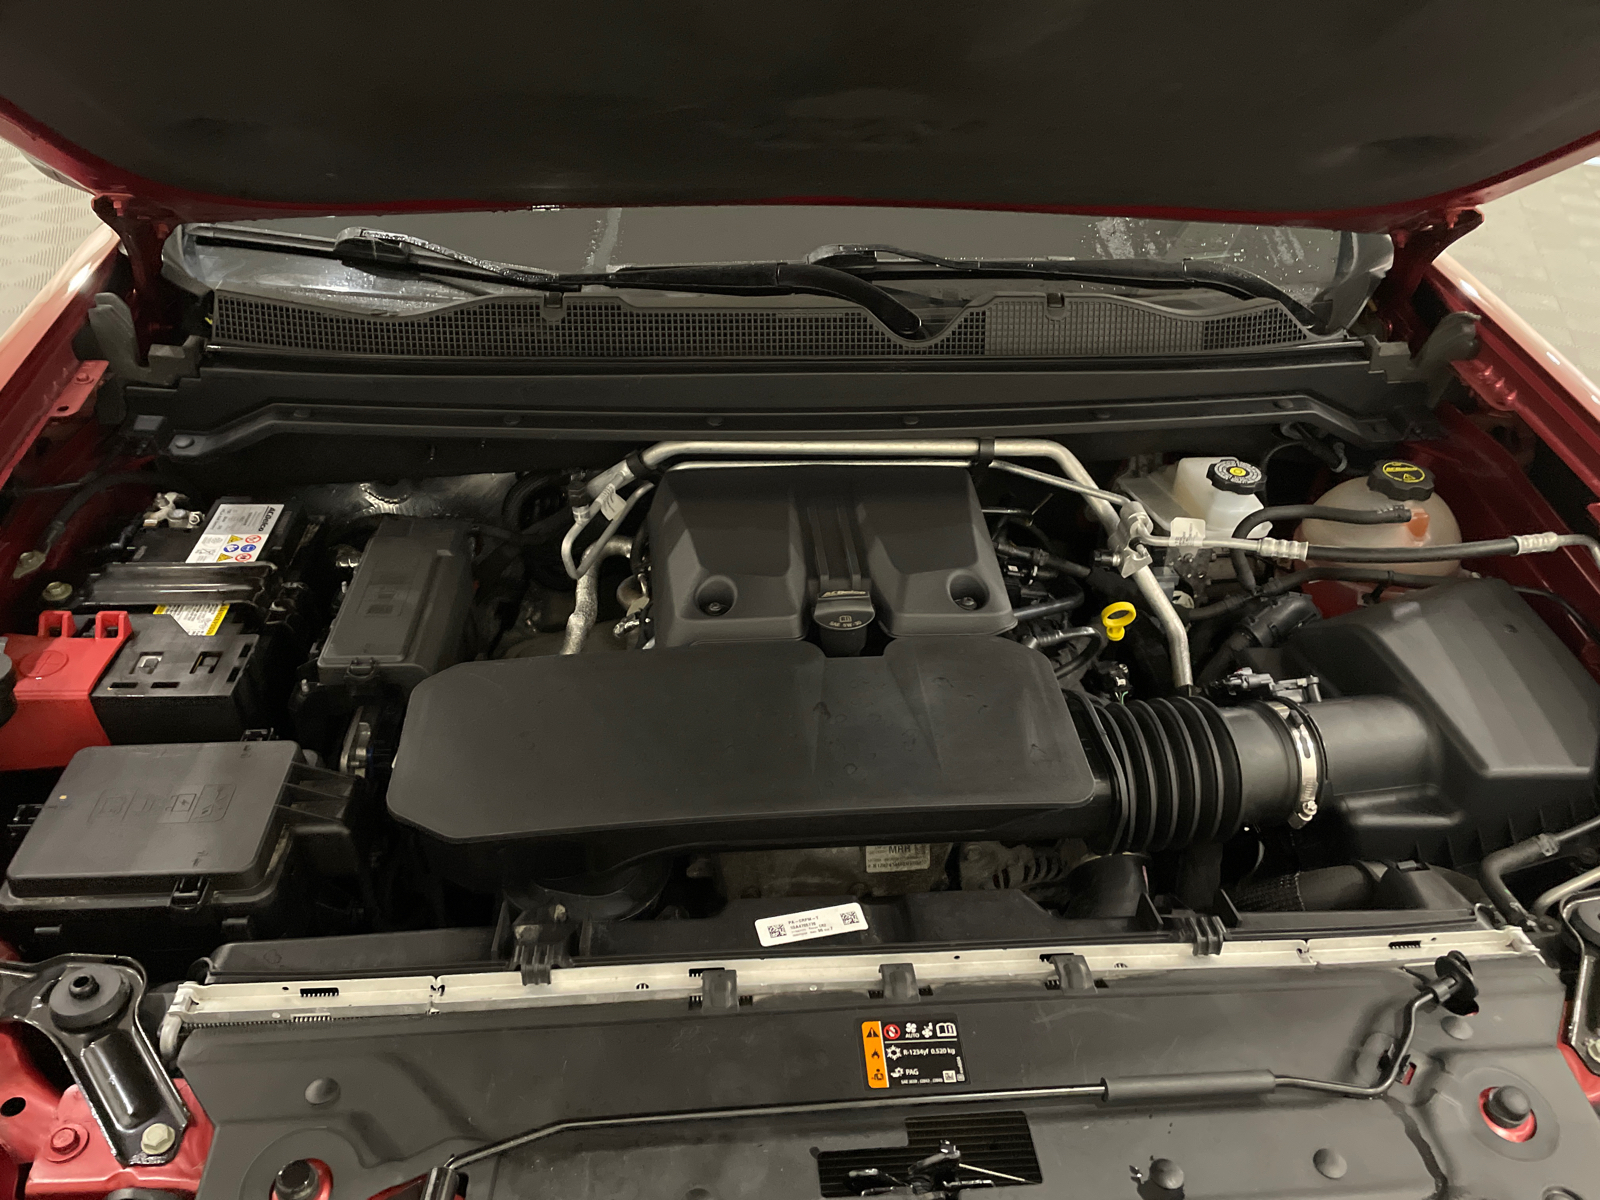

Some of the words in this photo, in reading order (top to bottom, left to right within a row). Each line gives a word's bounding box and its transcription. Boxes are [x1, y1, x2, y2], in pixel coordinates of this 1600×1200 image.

[930, 1047, 947, 1055] 0.520
[947, 1047, 956, 1056] kg
[905, 1068, 920, 1076] PAG
